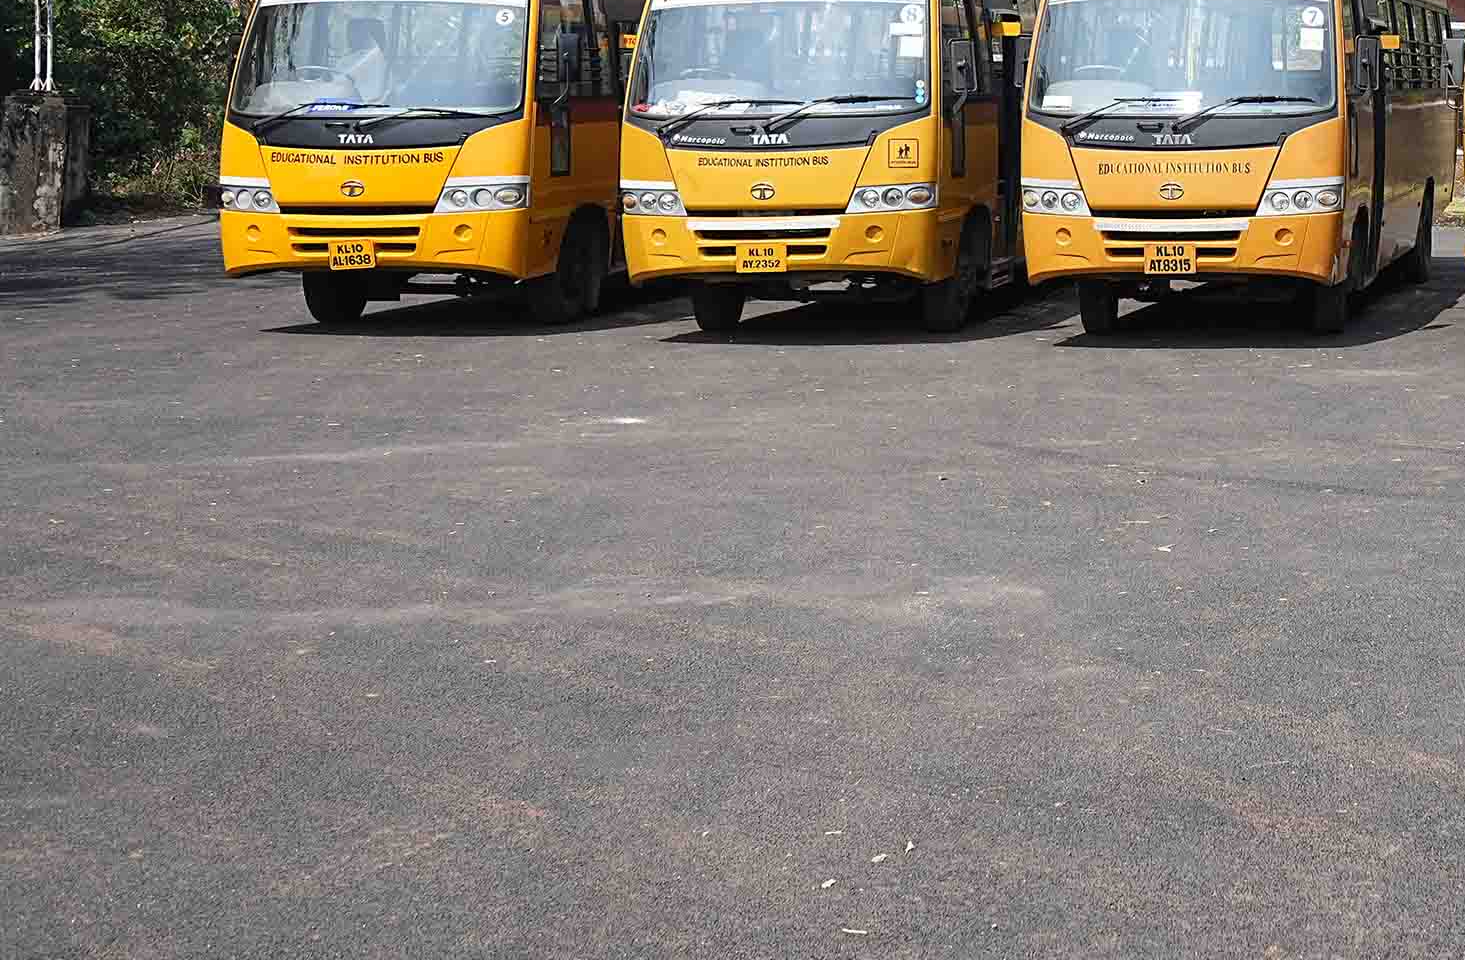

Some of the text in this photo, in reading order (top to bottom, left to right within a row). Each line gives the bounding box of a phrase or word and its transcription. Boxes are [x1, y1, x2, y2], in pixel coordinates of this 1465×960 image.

[501, 12, 509, 22] 5
[1309, 10, 1318, 24] 7
[337, 133, 374, 144] TATA
[680, 135, 727, 145] Marcopolo
[750, 133, 788, 144] TATA
[1152, 134, 1193, 145] TATA
[271, 151, 444, 165] EDUCATIONAL INSTITUTION BUS
[697, 156, 829, 167] EDUCATIONAL INSTITUTION BUS
[1098, 162, 1250, 175] EDUCATIONAL INSTITUTION BUS
